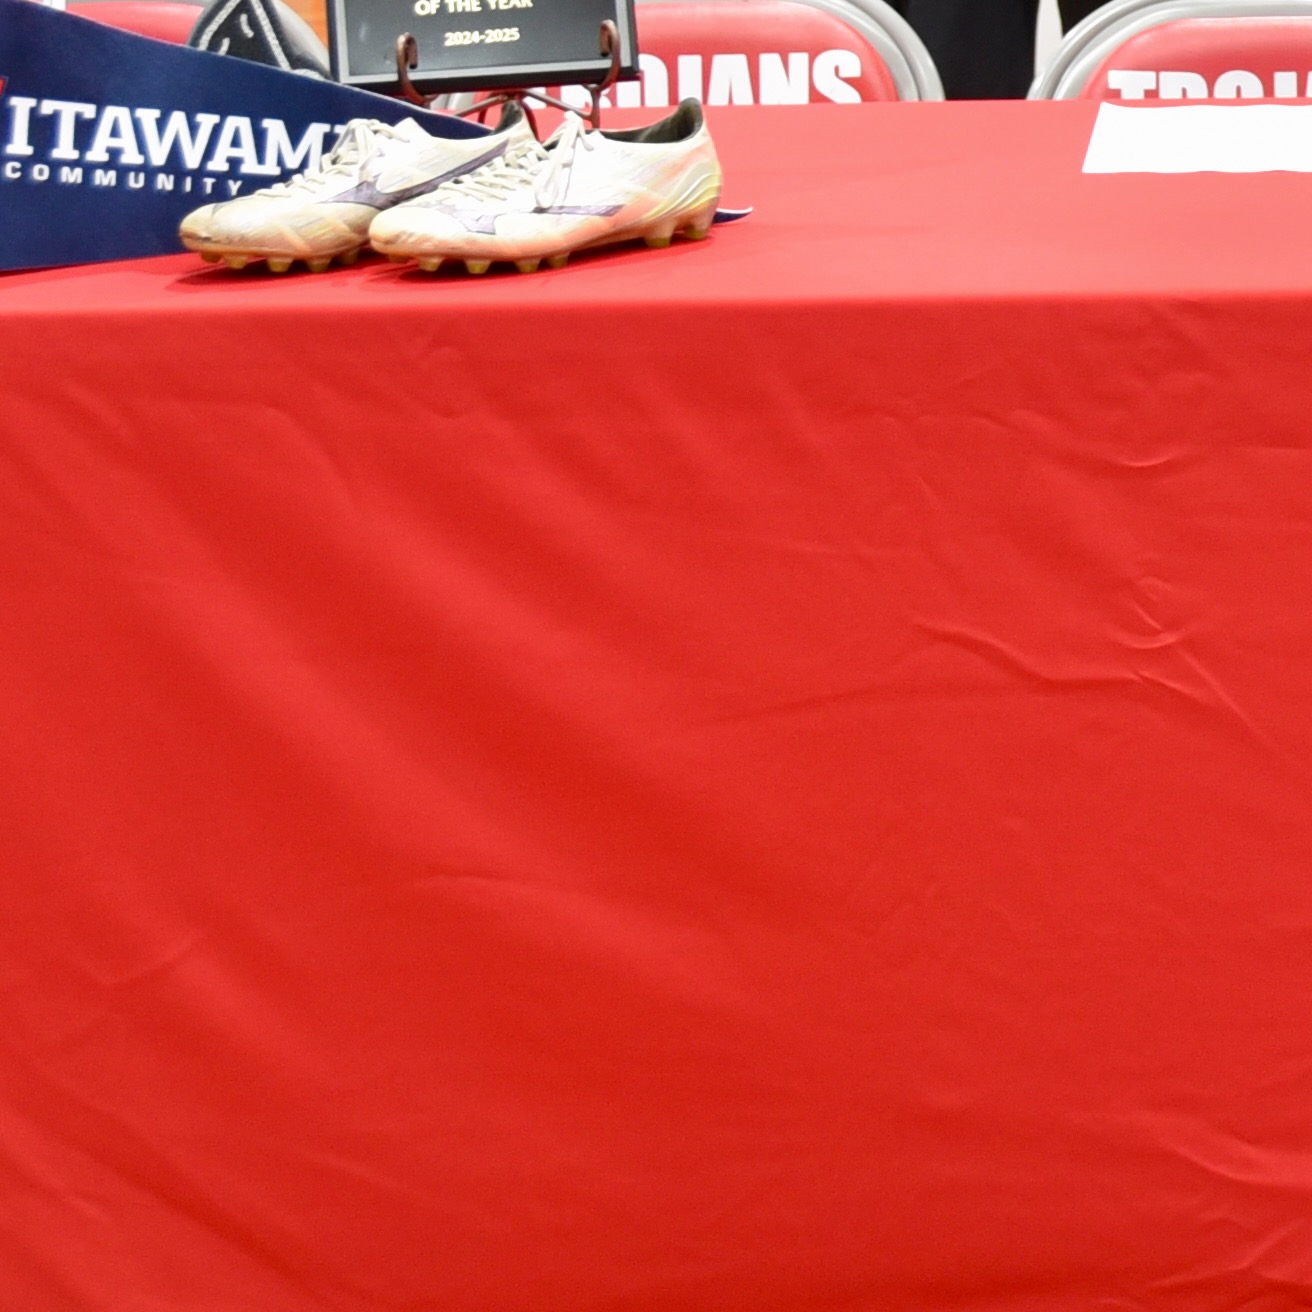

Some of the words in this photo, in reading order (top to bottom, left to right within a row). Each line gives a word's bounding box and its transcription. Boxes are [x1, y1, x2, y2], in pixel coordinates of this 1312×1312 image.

[414, 0, 441, 15] OF
[444, 27, 520, 46] 2024-2025
[5, 161, 243, 197] COMMUNITY
